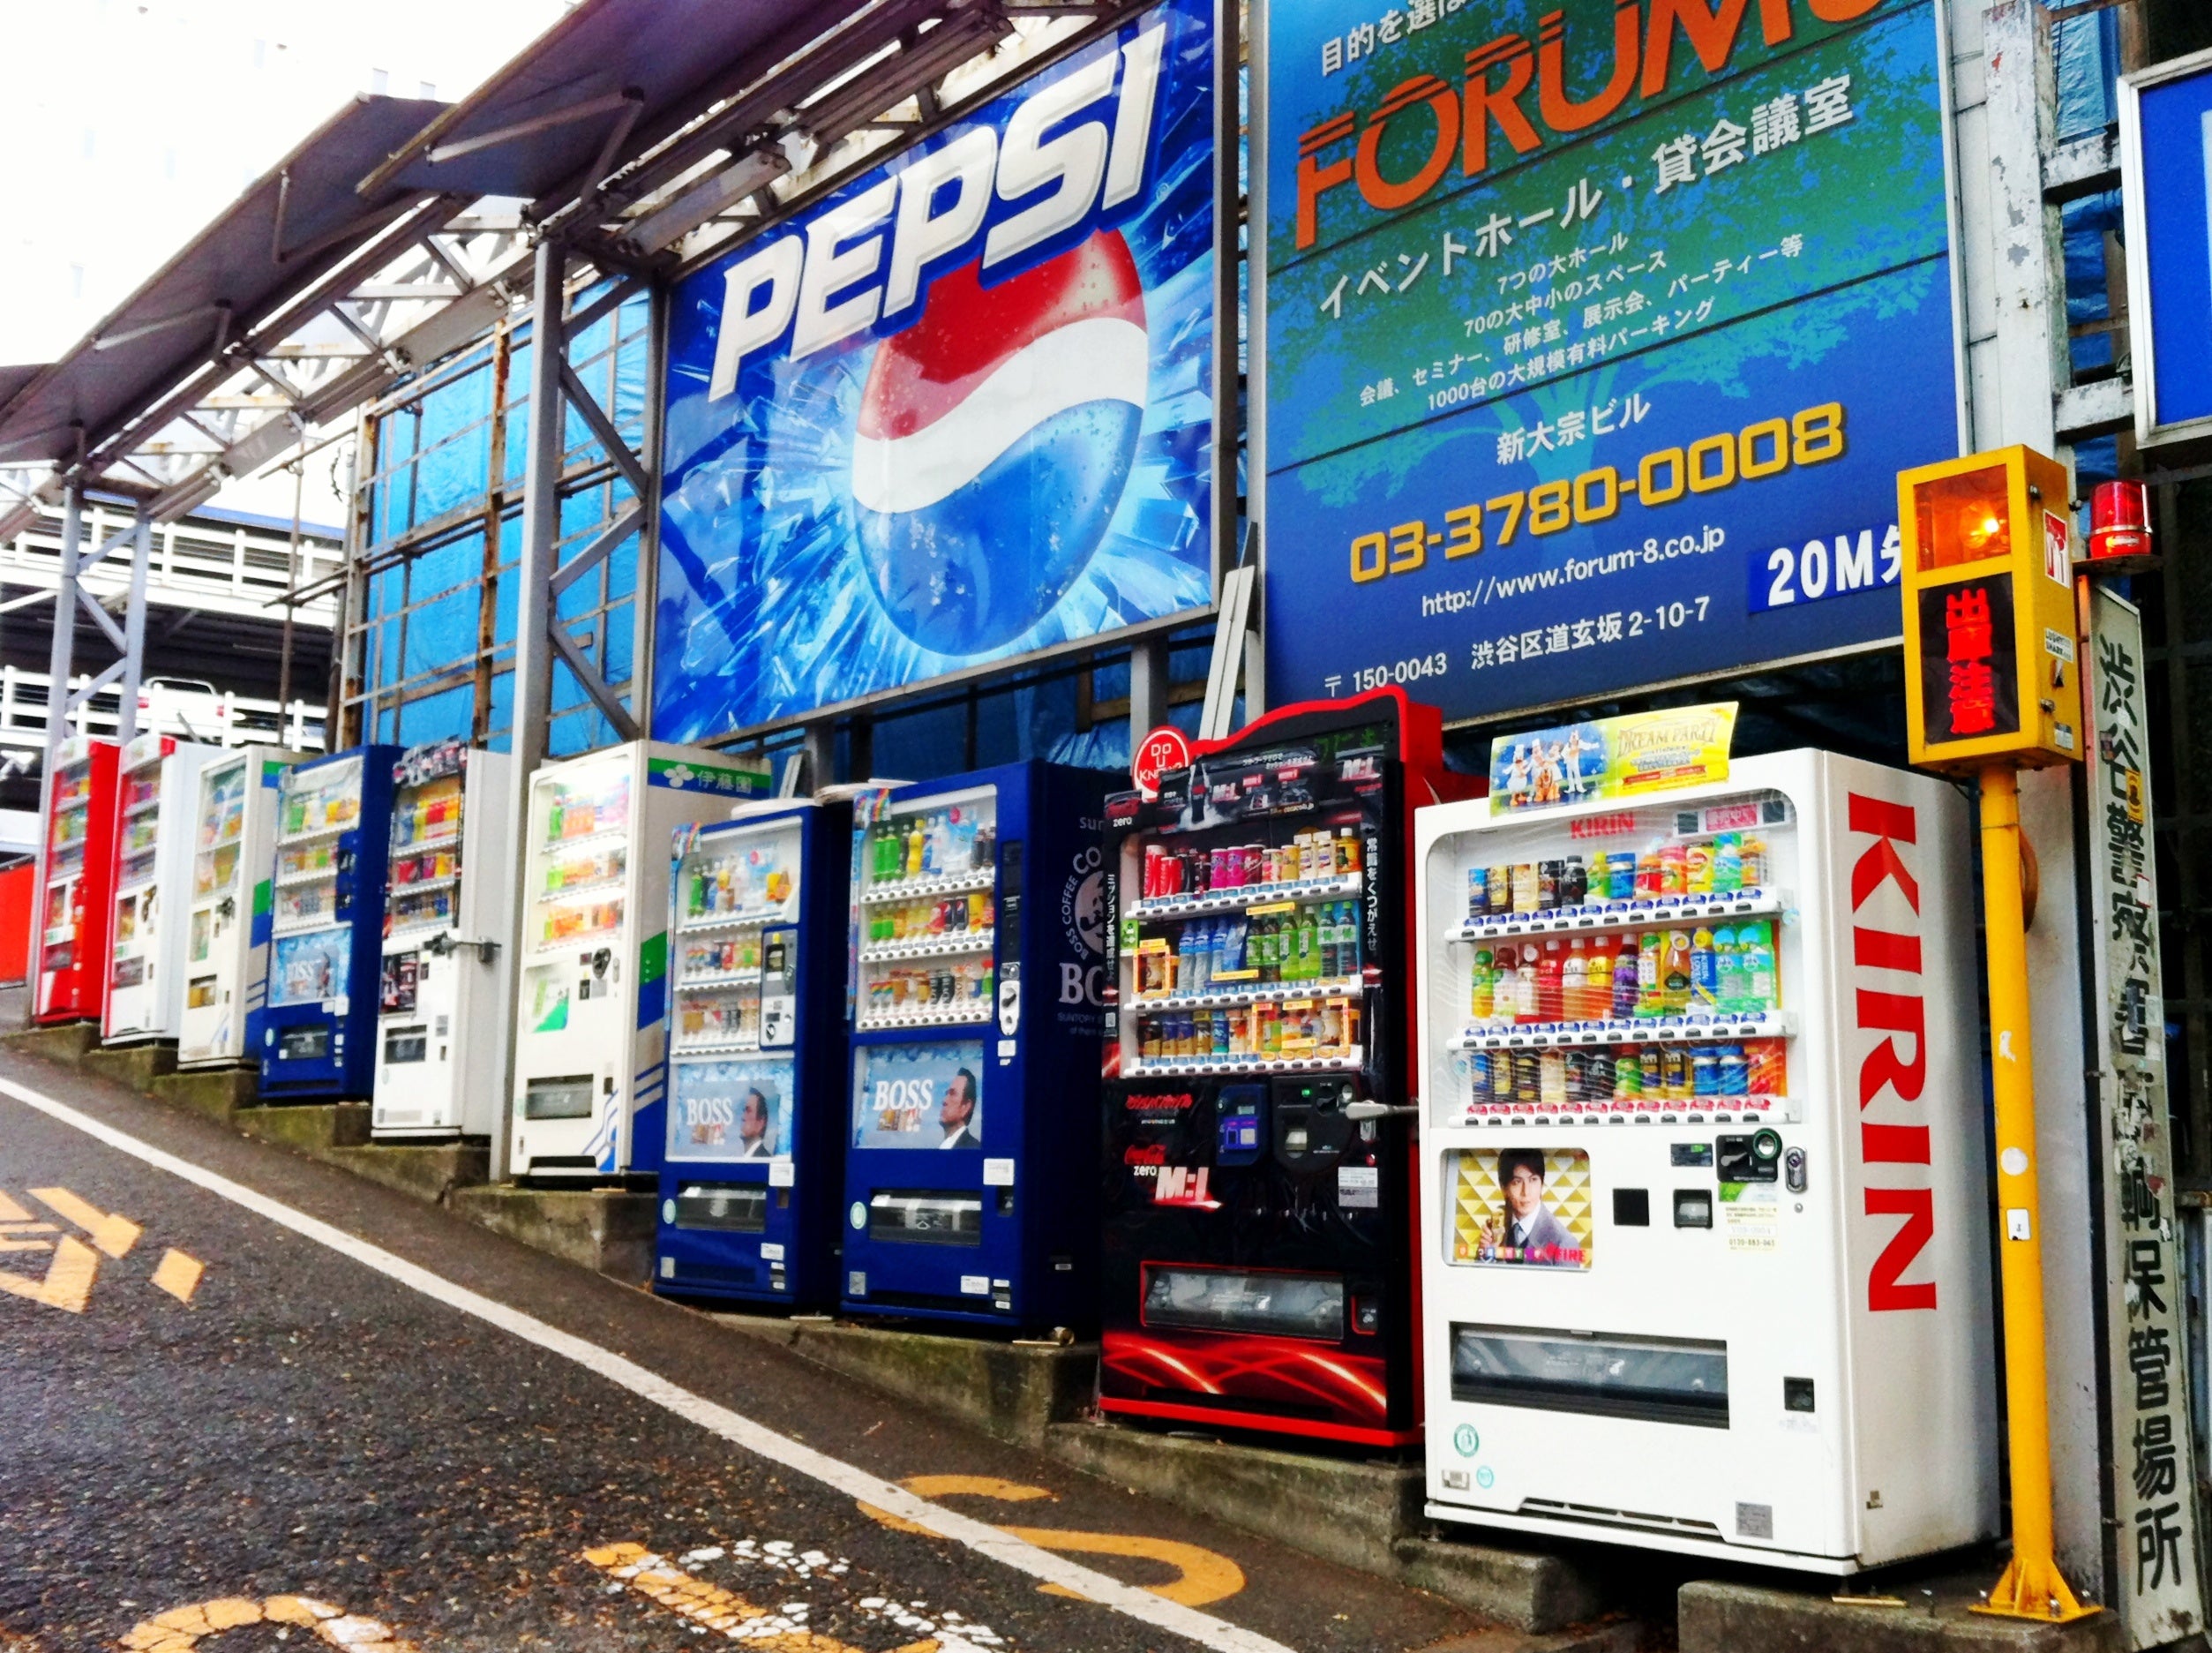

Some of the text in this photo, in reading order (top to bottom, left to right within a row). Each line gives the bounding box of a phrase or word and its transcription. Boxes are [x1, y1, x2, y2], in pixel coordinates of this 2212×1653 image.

[1295, 0, 1880, 251] FORUM
[709, 22, 1166, 402] PEPSI
[1465, 251, 1667, 337] 70の大中小のスペース
[1497, 232, 1629, 295] 7つの大ホール
[1428, 296, 1715, 410] 1000台の大規模有料パーキング
[1496, 394, 1652, 465] 新大宗ビル
[1350, 402, 1846, 583] 03-3780-0008
[1421, 524, 1726, 617] http://www.forum-8.co.jp
[1353, 652, 1447, 693] 150-0043
[1471, 612, 1622, 670] 渋谷区道玄坂
[1629, 596, 1710, 637] 2-10-7
[1151, 743, 1172, 757] DO
[1156, 755, 1166, 768] U
[1113, 816, 1132, 828] zero
[1570, 811, 1635, 839] KIRIN
[1061, 875, 1078, 925] COFFEE
[1848, 791, 1938, 1312] KIRIN
[686, 1098, 736, 1127] BOSS
[873, 1079, 934, 1111] BOSS
[1133, 1166, 1158, 1176] zero
